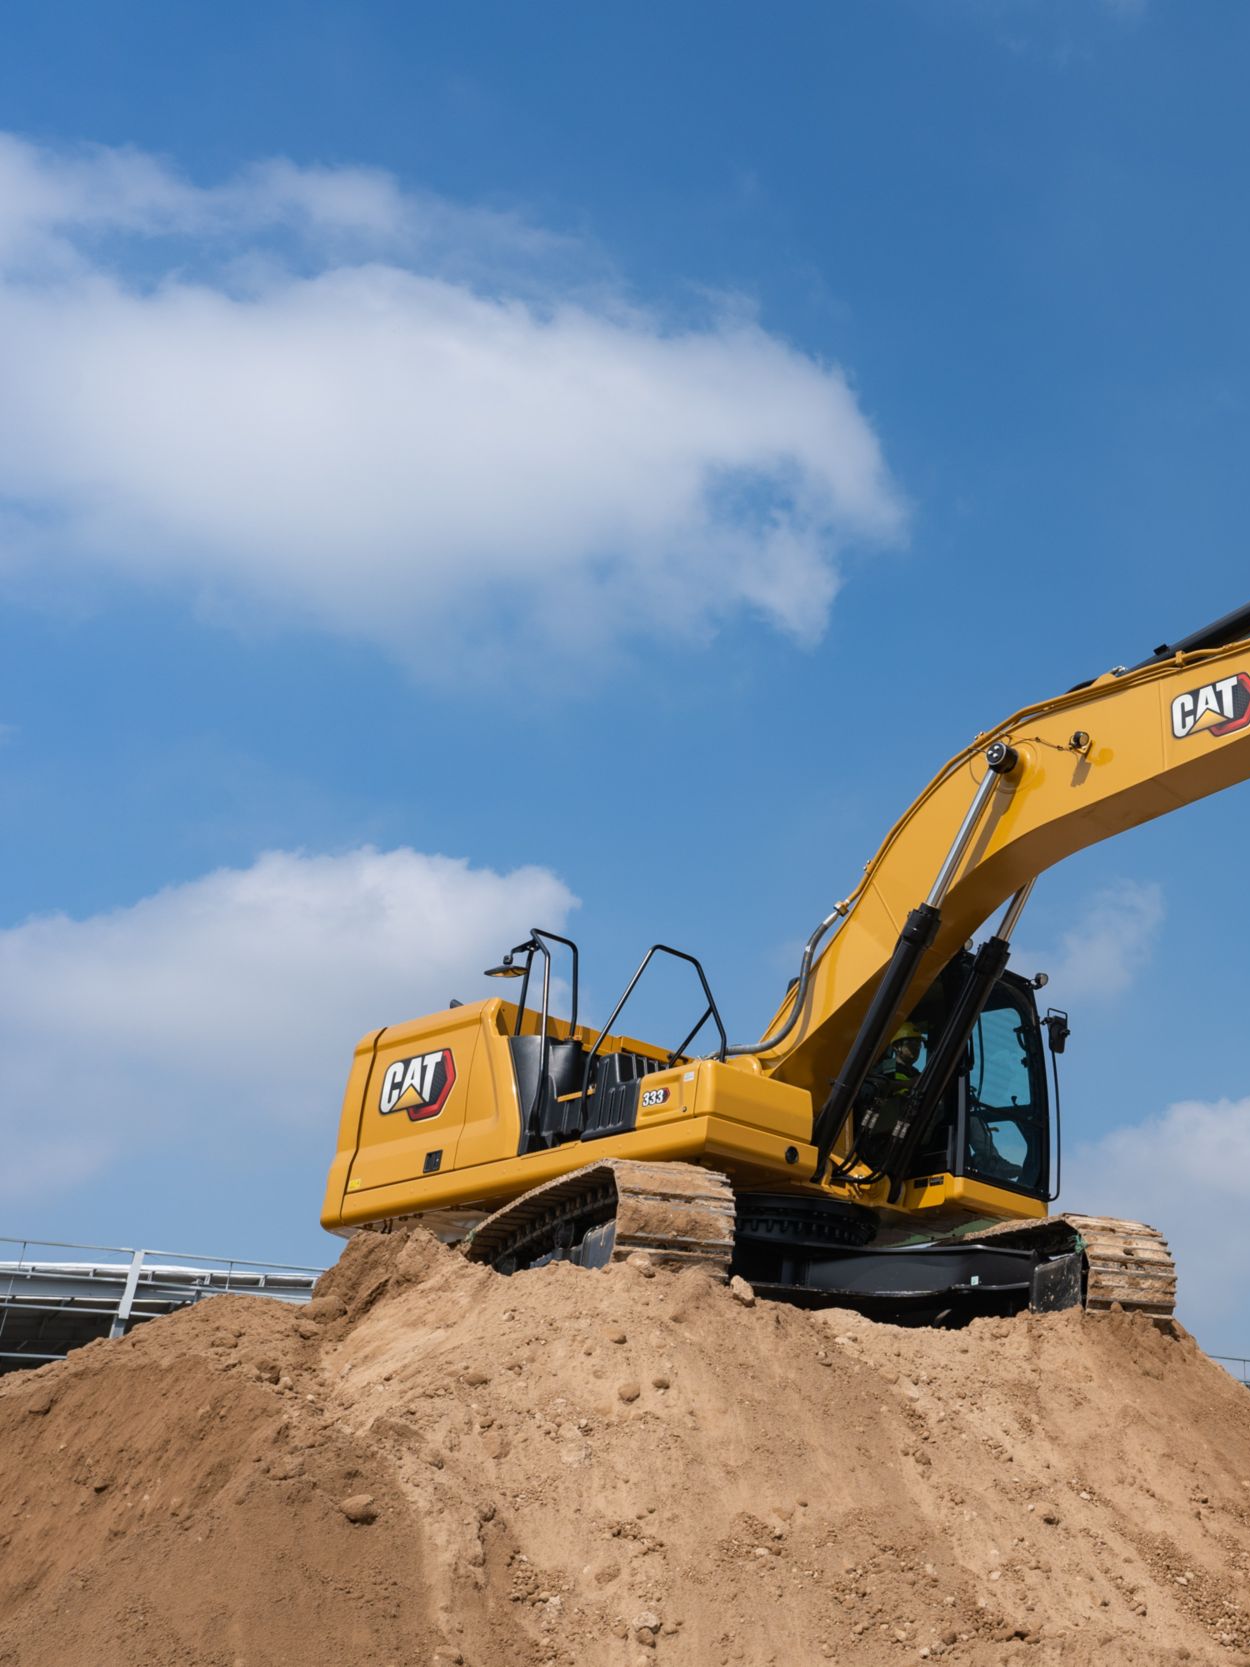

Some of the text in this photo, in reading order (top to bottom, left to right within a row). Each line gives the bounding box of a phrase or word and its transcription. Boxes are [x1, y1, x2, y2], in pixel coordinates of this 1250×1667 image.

[1172, 675, 1238, 738] CAT
[380, 1051, 443, 1114] CAT
[642, 1088, 664, 1107] 333
